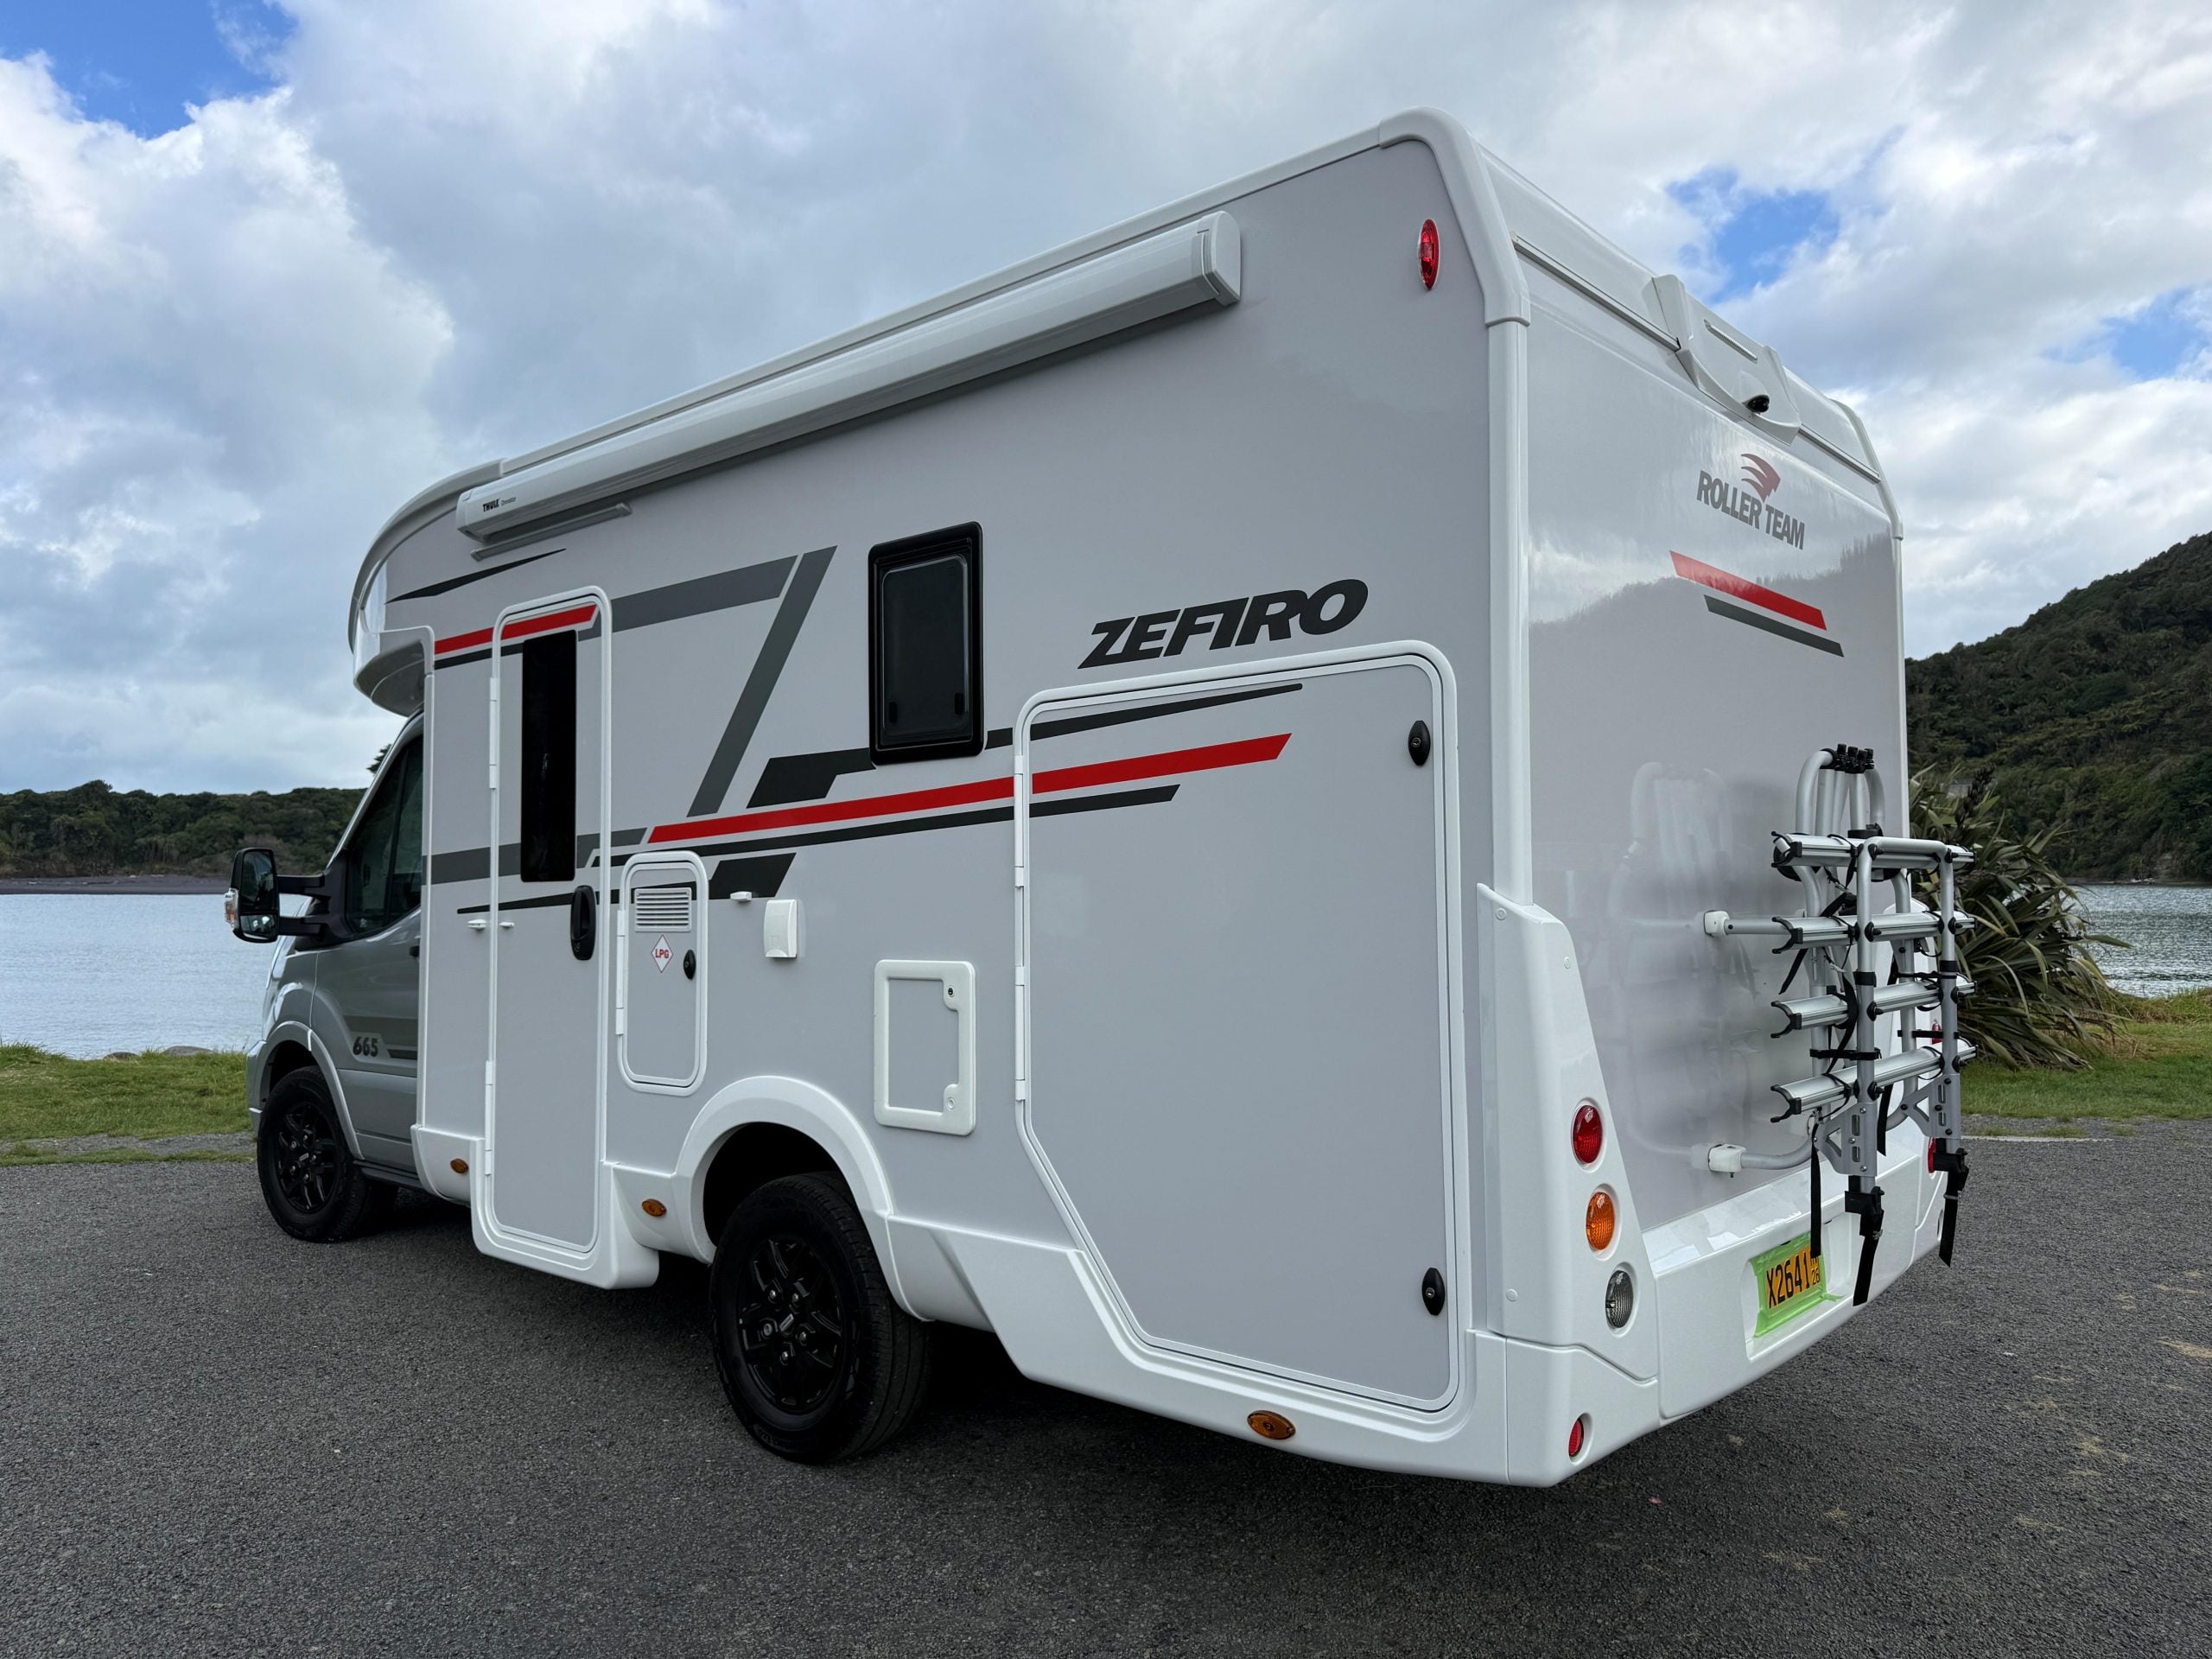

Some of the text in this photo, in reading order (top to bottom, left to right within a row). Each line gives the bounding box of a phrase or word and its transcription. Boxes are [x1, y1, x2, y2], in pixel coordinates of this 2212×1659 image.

[483, 499, 499, 512] THULE
[1696, 470, 1805, 550] ROLLER TEAM
[1077, 579, 1369, 670] ZEFIRO
[655, 949, 670, 959] LPG
[353, 1036, 378, 1058] 665
[1766, 1251, 1810, 1309] X2641
